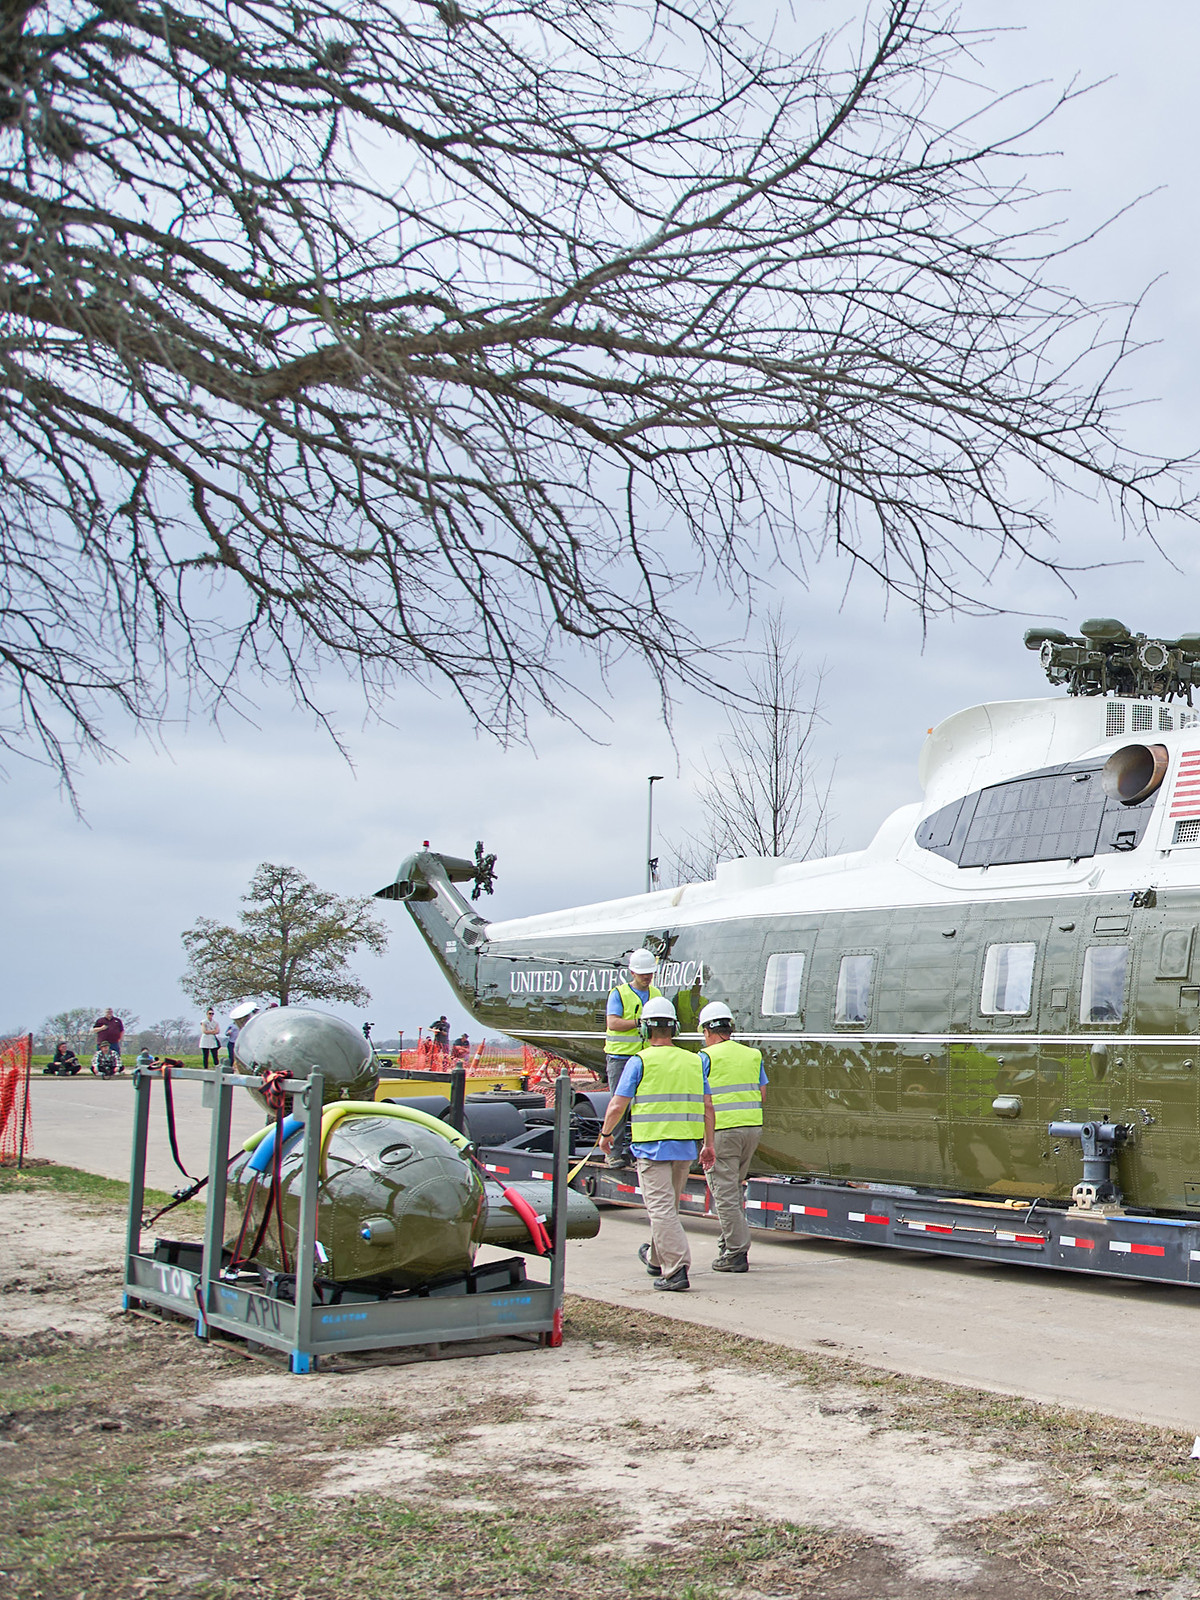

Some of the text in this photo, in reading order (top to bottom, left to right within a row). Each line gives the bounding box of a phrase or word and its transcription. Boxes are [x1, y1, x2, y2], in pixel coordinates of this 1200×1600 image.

[510, 960, 705, 993] UNITED STATES MERICA
[246, 1293, 281, 1331] APU
